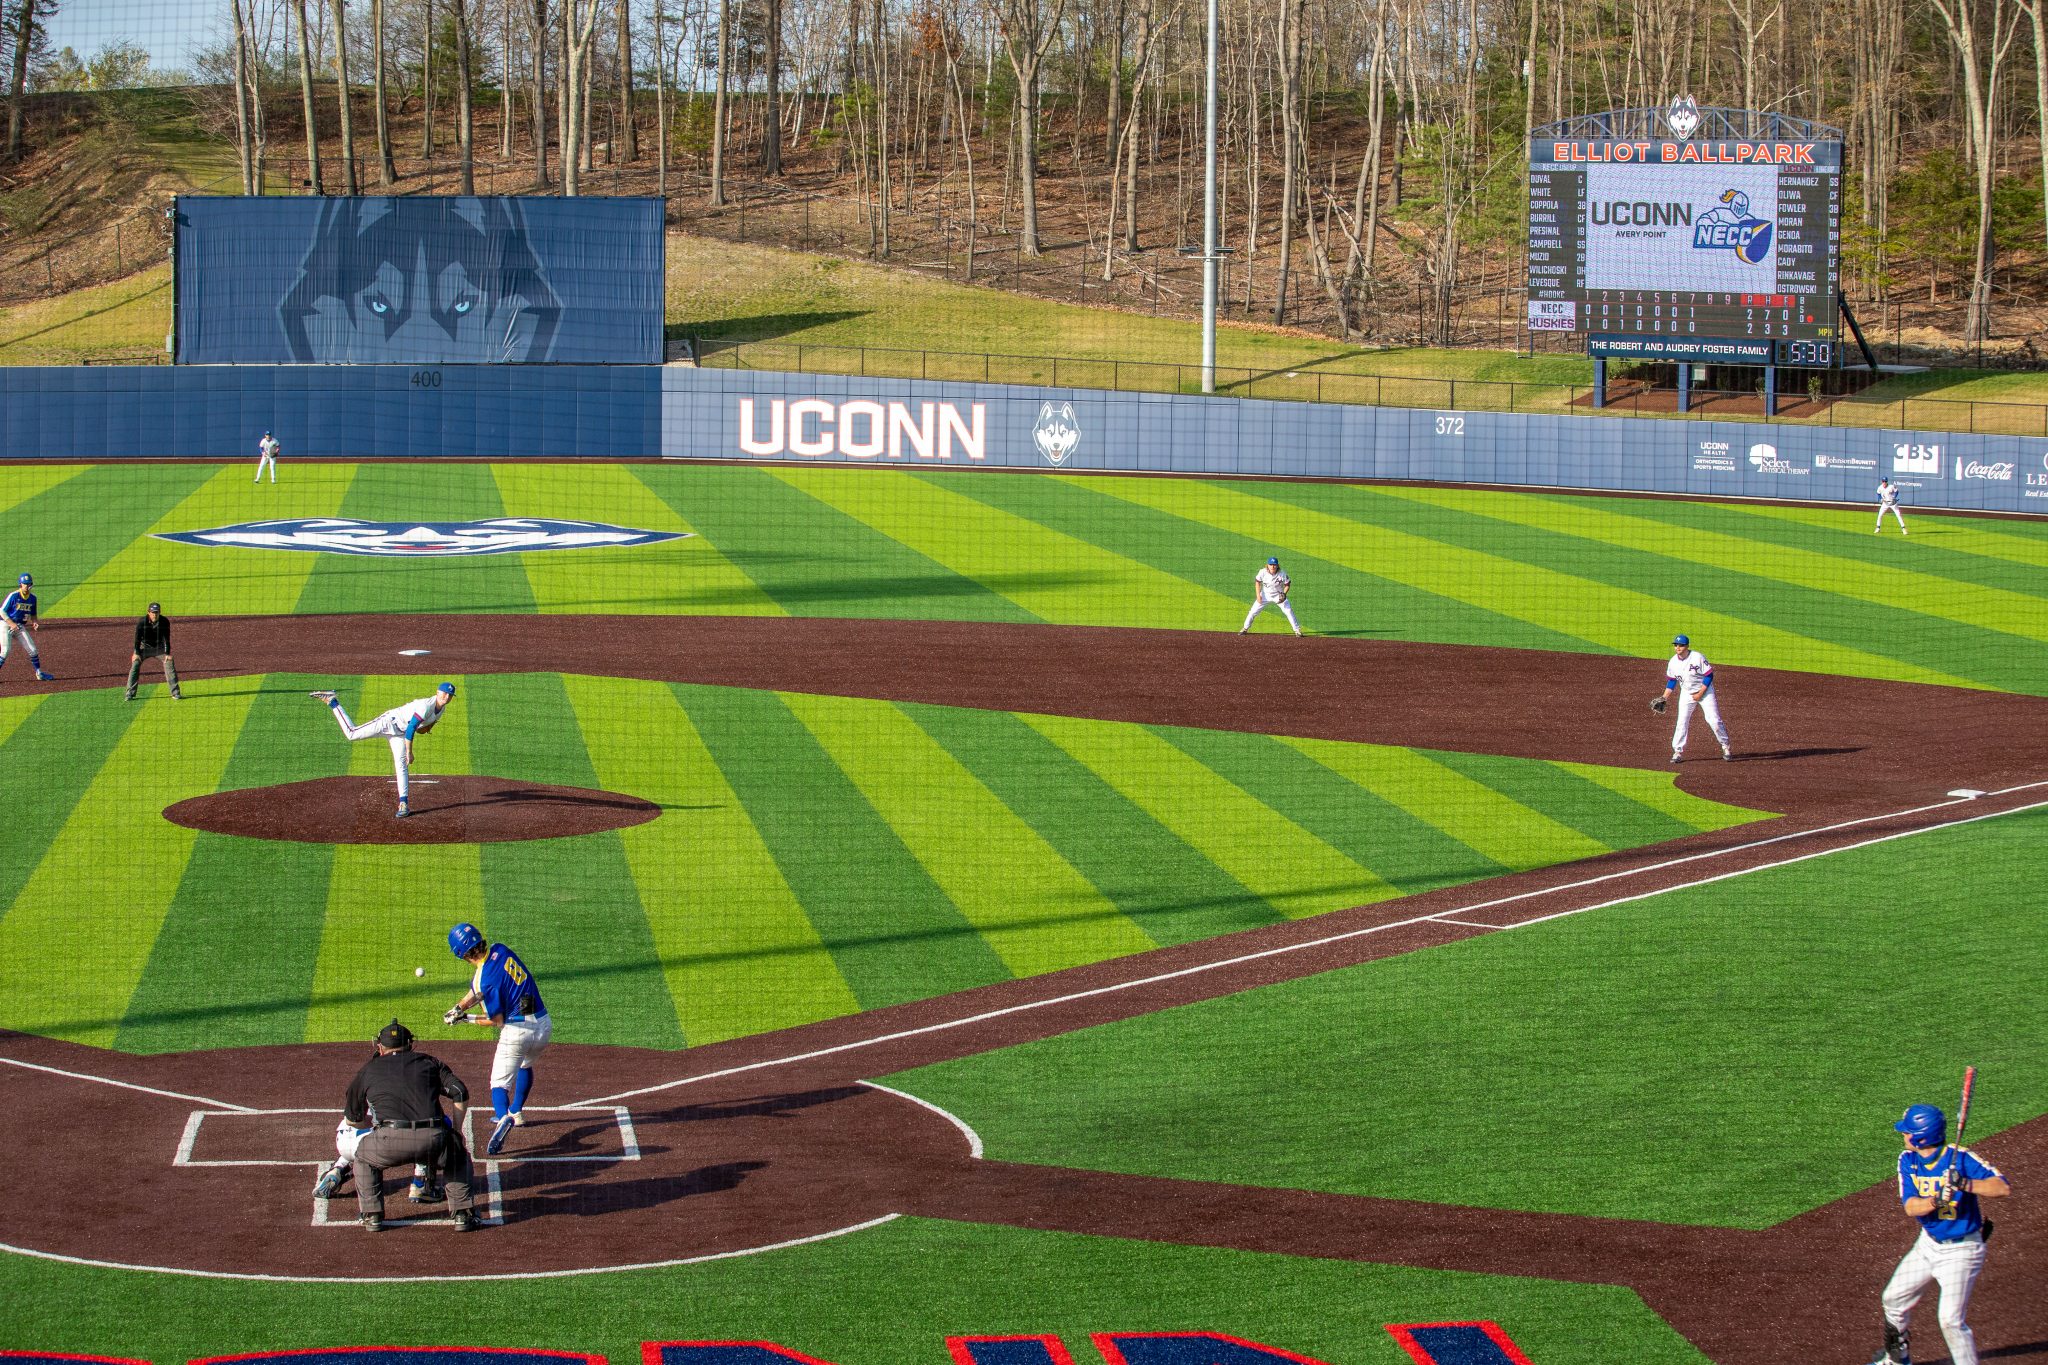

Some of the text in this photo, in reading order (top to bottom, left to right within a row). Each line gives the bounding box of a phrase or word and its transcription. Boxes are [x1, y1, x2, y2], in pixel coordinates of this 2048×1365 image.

[1553, 142, 1815, 164] ELLIOT BALLPARK
[1784, 165, 1813, 173] UCONN
[1530, 175, 1582, 184] DUVAL C
[1779, 177, 1839, 186] HERNANDEZ SS
[1530, 188, 1585, 197] WHITE LF
[1830, 191, 1838, 200] CF
[1530, 201, 1586, 210] COPPOLA 3B
[1778, 204, 1838, 213] FOWLER 3B
[1591, 201, 1692, 226] UCONN
[1578, 214, 1586, 223] CF
[1778, 218, 1837, 227] MORAN 1B
[1530, 227, 1585, 236] PRESINAL 1B
[1616, 230, 1640, 238] AVERY
[1696, 225, 1753, 246] NECC
[1778, 231, 1838, 240] GENOA DH
[1530, 240, 1586, 248] CAMPBELL SS
[1778, 244, 1837, 254] MORABITO RF
[1577, 254, 1585, 262] 2B
[1778, 258, 1836, 267] CADY LF
[1577, 266, 1585, 275] DH
[1778, 272, 1837, 281] RINKAVAGE 2B
[1529, 278, 1585, 288] LEVESQUE RF
[1778, 284, 1833, 294] OSTROWSKI C
[1586, 291, 1590, 300] 1
[1602, 291, 1608, 301] 2
[1620, 291, 1624, 302] 3
[1637, 292, 1642, 302] 4
[1654, 292, 1660, 303] 5
[1672, 293, 1677, 304] 6
[1690, 294, 1695, 304] 7
[1708, 294, 1712, 304] 8
[1725, 295, 1730, 304] 9
[1748, 295, 1752, 304] R
[1766, 295, 1770, 305] H
[1800, 297, 1804, 305] B
[1541, 303, 1788, 320] NECC 0 0 1 0 0 0 1 2 7 0
[1528, 318, 1788, 335] HUSKIES 1 0 1 0 0 0 0 2 3 3
[1818, 328, 1833, 336] MPH
[1591, 341, 1768, 356] THE ROBERT AND AUDREY FOSTER FAMILY
[1792, 344, 1829, 363] 5:30
[411, 371, 442, 387] 400
[740, 398, 986, 460] UCONN
[1436, 417, 1464, 435] 372
[1701, 442, 1728, 450] UCONN
[1894, 444, 1933, 460] CBS
[1762, 457, 1789, 468] Select
